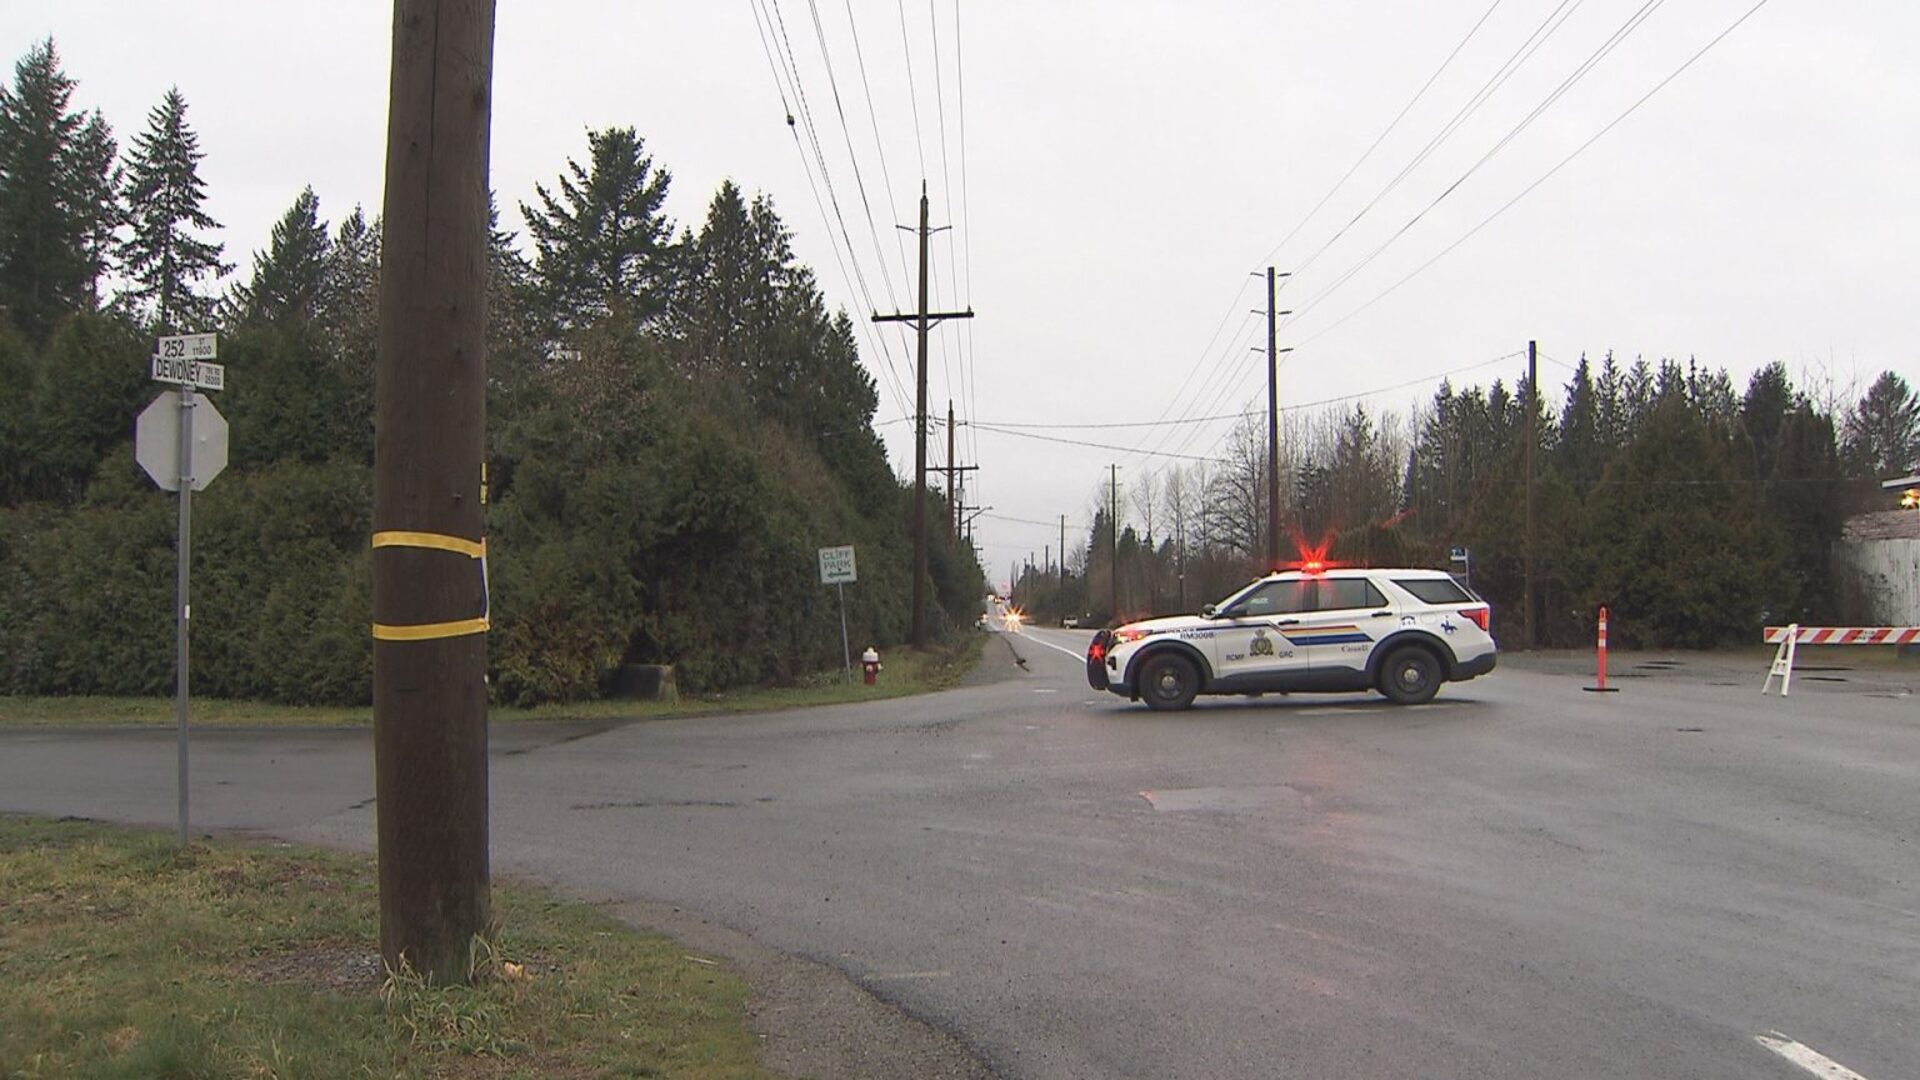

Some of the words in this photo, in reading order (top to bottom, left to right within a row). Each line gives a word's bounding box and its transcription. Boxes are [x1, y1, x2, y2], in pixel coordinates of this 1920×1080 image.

[164, 339, 185, 357] 252
[156, 358, 201, 383] DEWDNEY
[822, 551, 850, 560] CLIFF
[823, 560, 851, 569] PARK
[1226, 653, 1245, 661] RCMP
[1279, 650, 1294, 659] GRC
